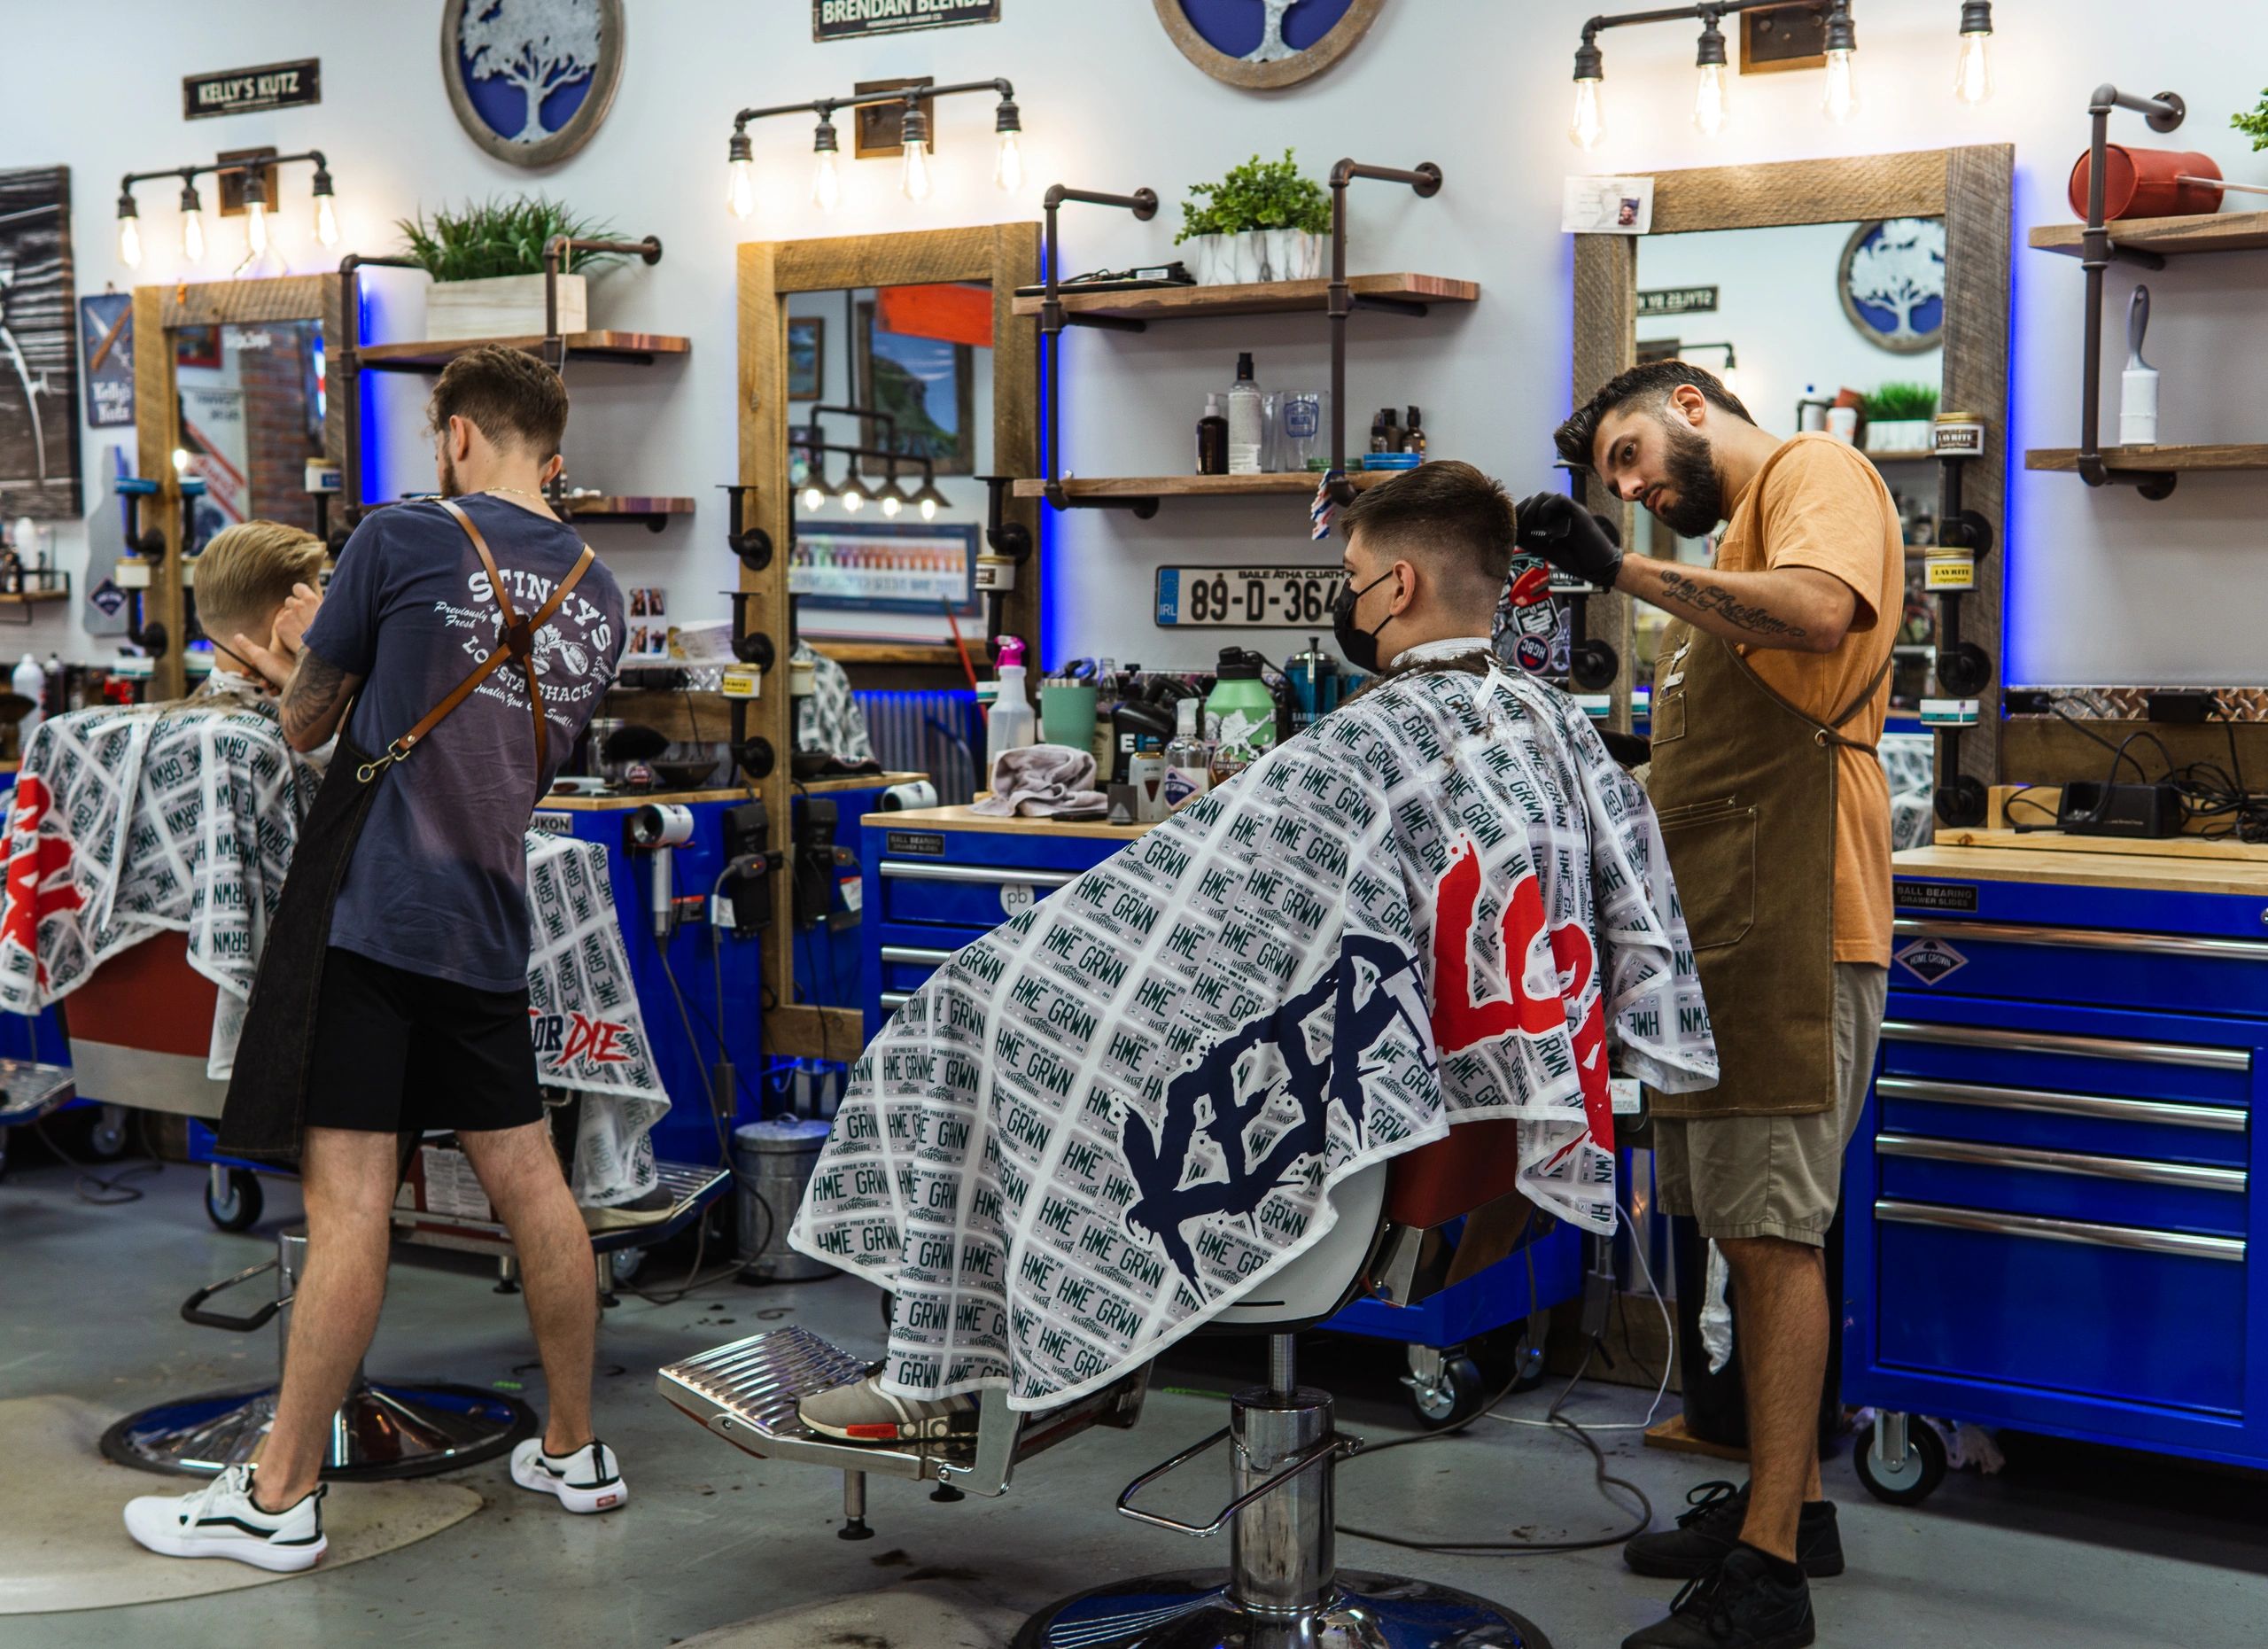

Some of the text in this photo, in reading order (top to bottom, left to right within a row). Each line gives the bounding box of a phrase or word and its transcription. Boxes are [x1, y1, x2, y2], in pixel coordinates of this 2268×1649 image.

[822, 0, 990, 24] BRENDAN BLEN
[198, 77, 254, 105] KELLY'S
[257, 72, 299, 96] KUTZ
[1239, 571, 1271, 579] BAILE
[433, 601, 488, 622] Previously
[445, 614, 476, 630] Fresh
[1160, 603, 1177, 617] IRL
[462, 635, 526, 693] LOSTA
[1520, 639, 1547, 659] HGBC
[507, 694, 523, 708] You
[1293, 712, 1328, 722] BARBIC
[1332, 719, 1404, 790] HME GRWN
[1402, 715, 1444, 763] GRWN
[1262, 761, 1296, 792] HME
[1481, 744, 1545, 824] HME GRWN
[1299, 765, 1376, 829] HME GRWN
[533, 818, 570, 830] UKON
[1397, 798, 1432, 840] HME
[1463, 804, 1506, 849] GRWN
[1145, 840, 1191, 879] GRWN
[1270, 815, 1348, 879] HME GRWN
[534, 863, 565, 939] HME GRWN
[1075, 874, 1159, 935] HME GRWN
[1198, 868, 1234, 904] HME
[1245, 868, 1327, 930] HME GRWN
[1347, 870, 1385, 911] HME
[1897, 886, 1972, 898] BALL BEARING
[576, 893, 591, 923] HME
[1043, 924, 1129, 989] HME GRWN
[1166, 923, 1205, 961] HME
[1218, 921, 1299, 982] HME GRWN
[1910, 953, 1927, 965] HOME
[959, 945, 1005, 985] GRWN
[1011, 975, 1097, 1042] HME GRWN
[1135, 977, 1176, 1017] HME
[1192, 973, 1230, 1009] HME
[951, 999, 985, 1038] GRWN
[554, 1011, 636, 1068] DIE
[1108, 1032, 1148, 1071] HME
[996, 1028, 1074, 1097] HME GRWN
[1402, 1064, 1442, 1111] GRWN
[1006, 1108, 1051, 1153] GRWN
[1061, 1140, 1103, 1180] HME
[813, 1174, 846, 1202] HME
[1039, 1196, 1079, 1236] HME
[1260, 1200, 1308, 1239] GRWN
[818, 1227, 900, 1254] HME GRWN
[919, 1241, 953, 1270] GRWN
[1079, 1225, 1165, 1289] HME GRWN
[1196, 1230, 1233, 1265] HME
[962, 1246, 998, 1277] HME
[1021, 1251, 1054, 1291] HME
[909, 1302, 949, 1330] GRWN
[956, 1304, 985, 1332] HME
[1011, 1303, 1034, 1345] HME
[1056, 1276, 1142, 1340] HME GRWN
[1038, 1326, 1072, 1363] HME
